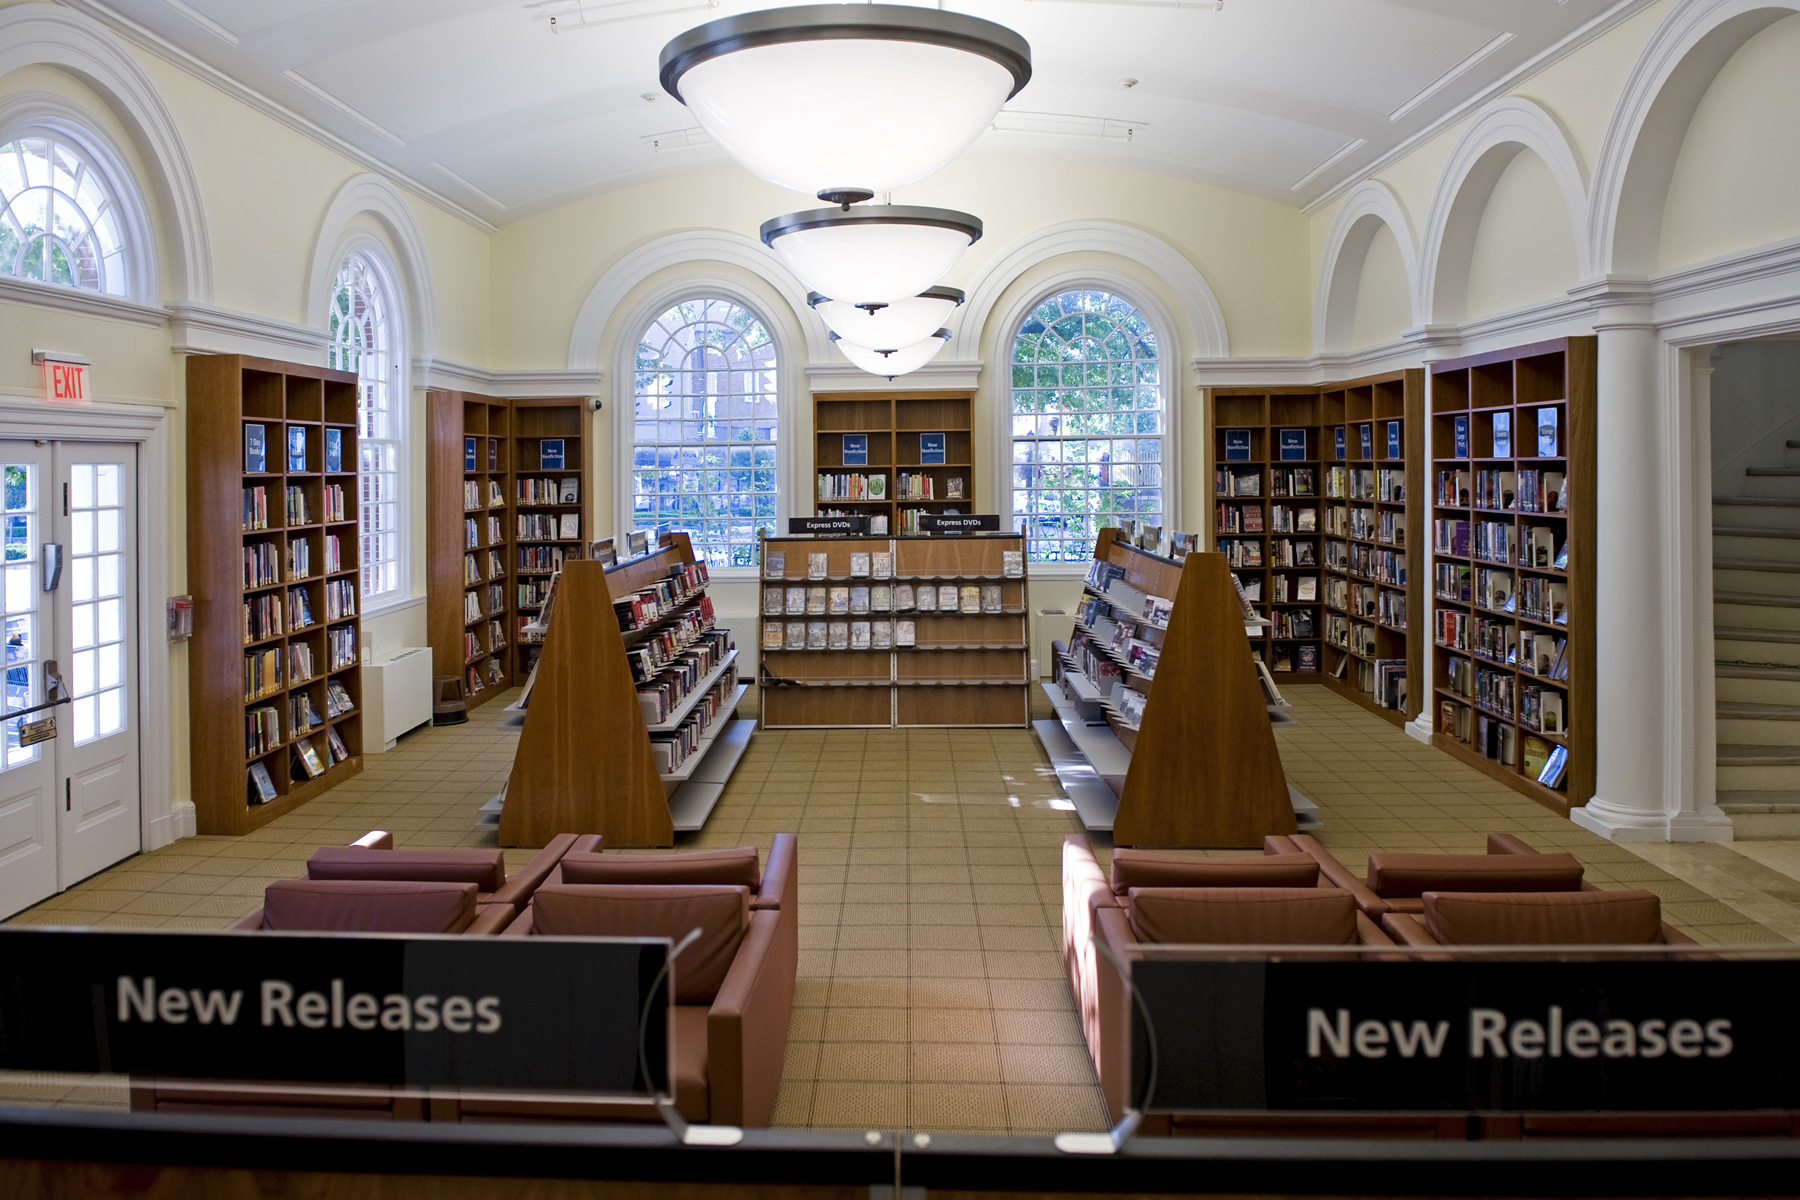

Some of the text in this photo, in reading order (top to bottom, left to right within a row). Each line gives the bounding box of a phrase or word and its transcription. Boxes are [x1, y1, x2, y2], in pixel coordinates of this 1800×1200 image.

[53, 365, 83, 399] EXIT
[249, 447, 261, 455] Books
[253, 438, 261, 448] Day
[936, 519, 962, 527] Express
[117, 976, 502, 1034] New Releases
[1307, 1006, 1734, 1058] New Releases
